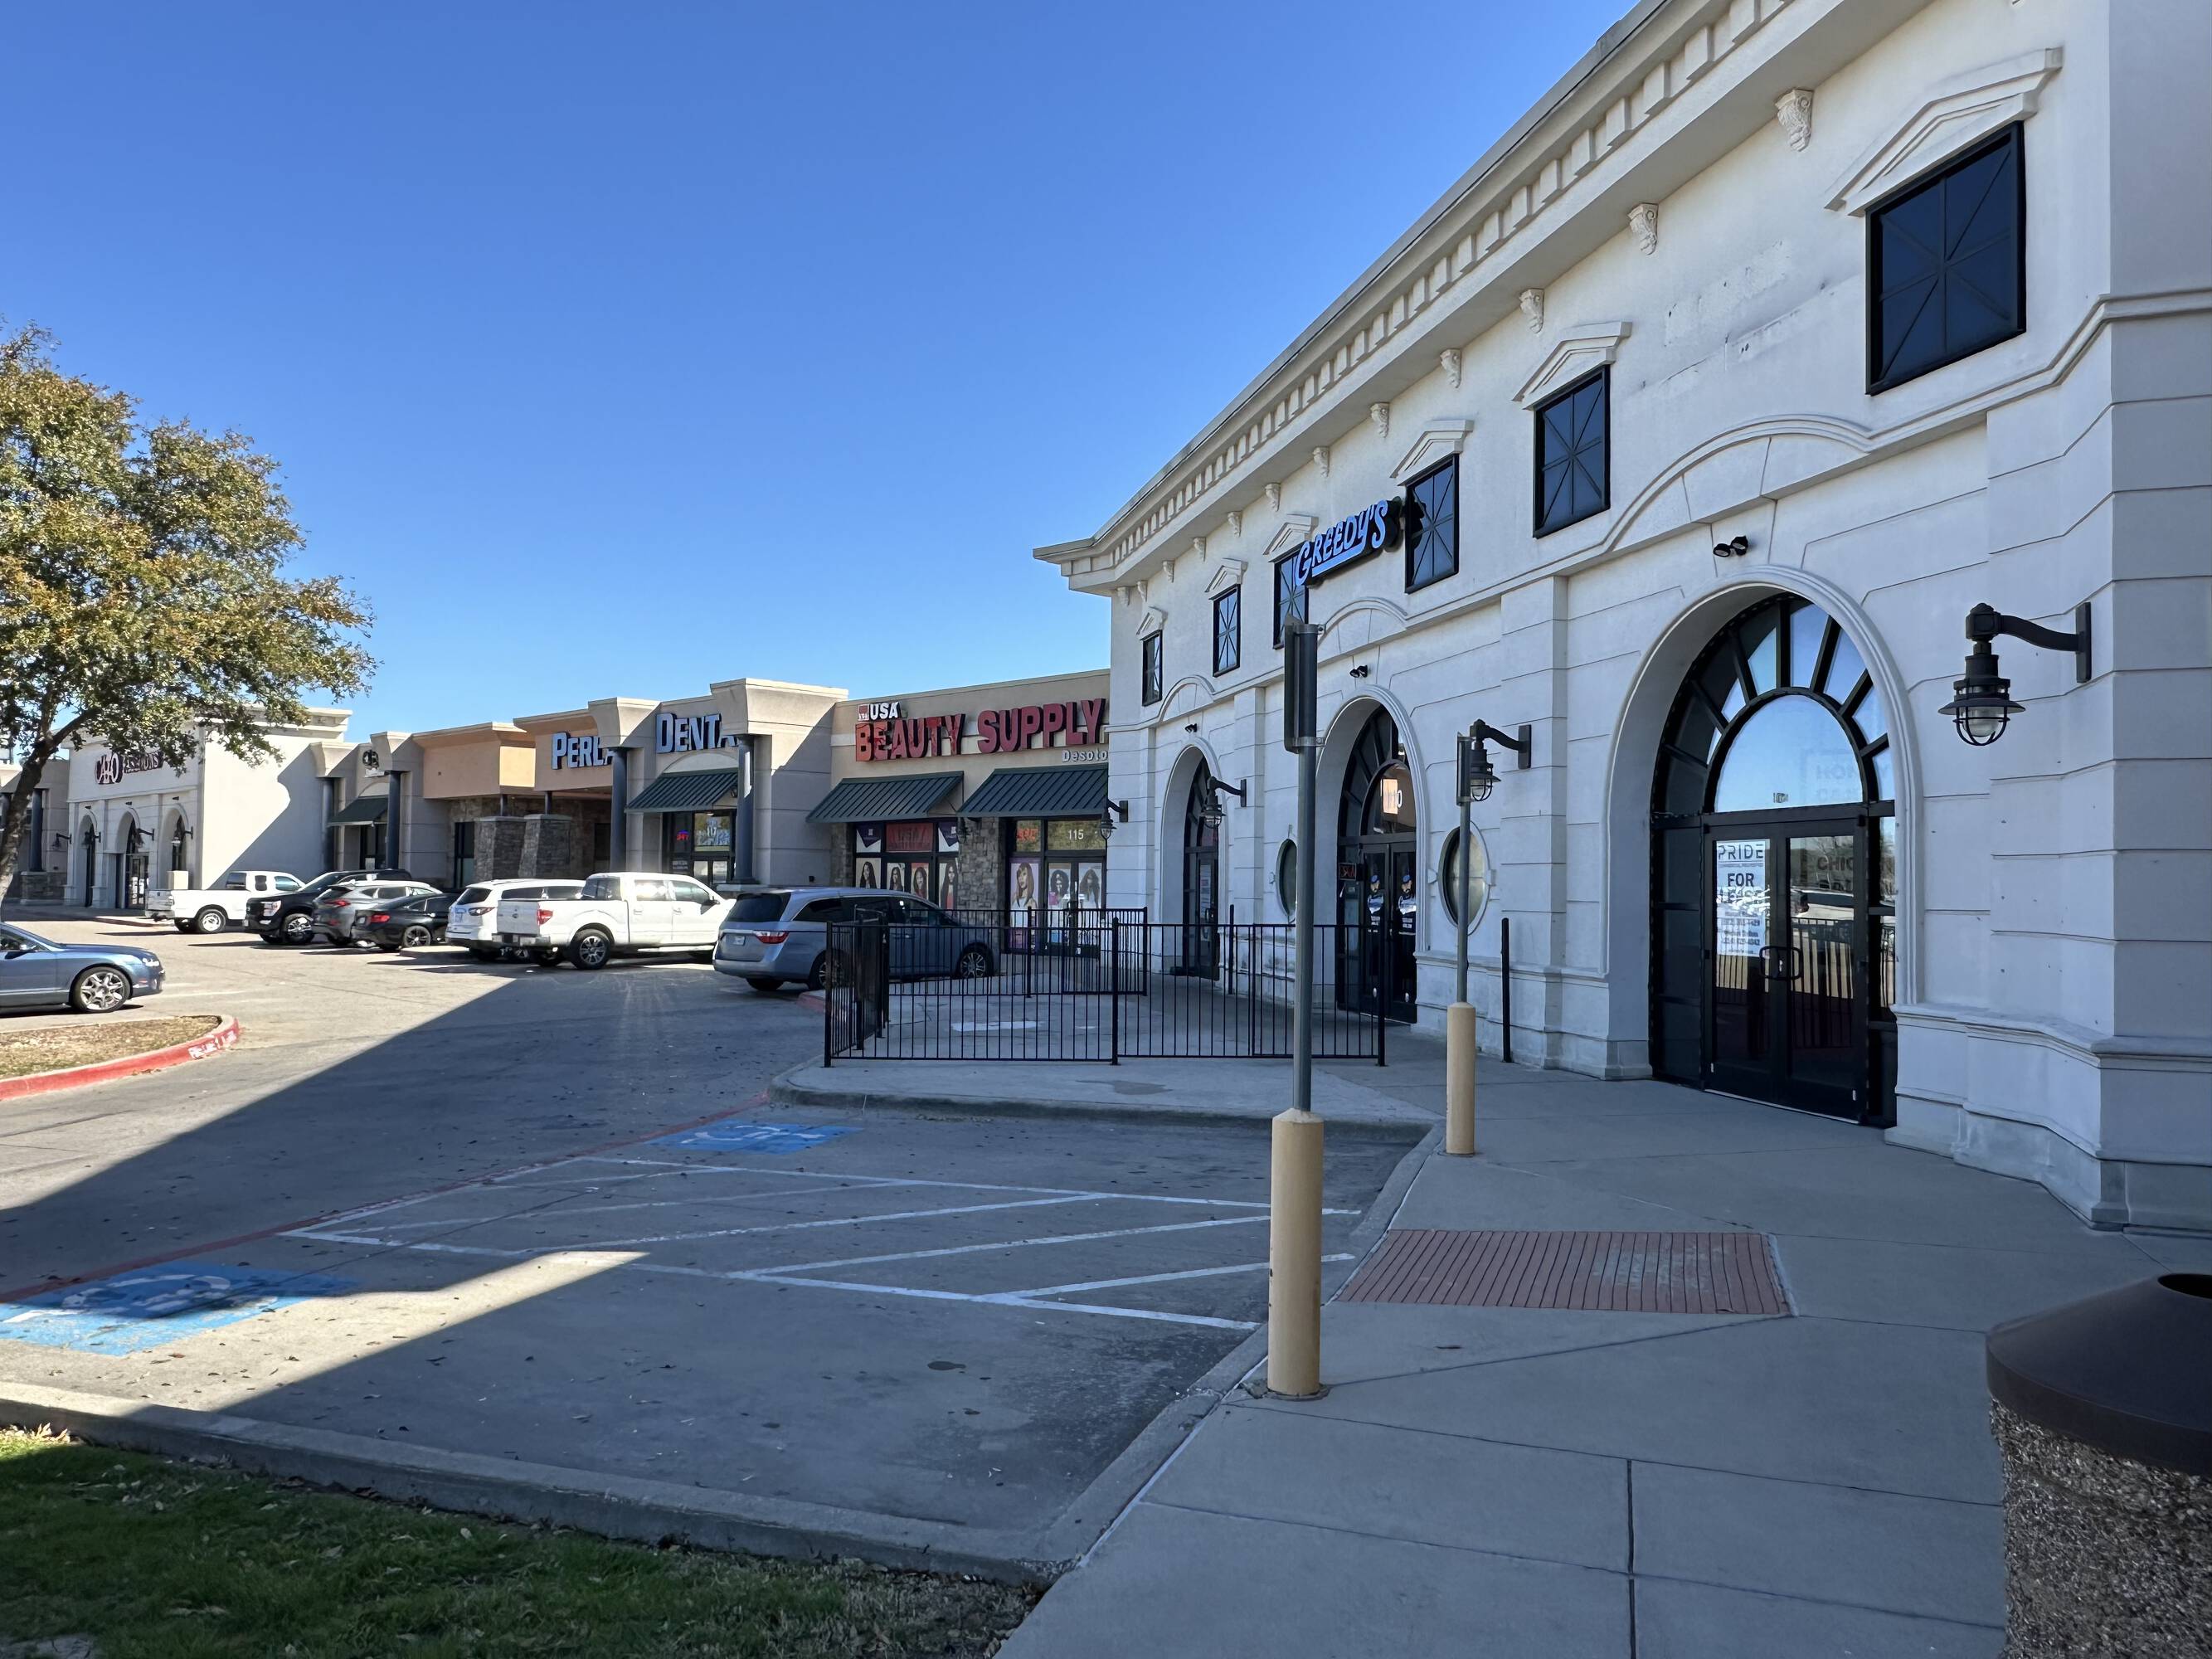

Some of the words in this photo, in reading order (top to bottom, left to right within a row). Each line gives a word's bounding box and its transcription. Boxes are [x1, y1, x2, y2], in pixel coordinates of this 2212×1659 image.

[1295, 499, 1388, 586] GREEDY'S
[870, 701, 900, 720] USA
[856, 713, 964, 761] BEAUTY
[977, 698, 1106, 753] SUPPLY
[1067, 829, 1085, 841] 115
[1718, 844, 1764, 860] PRIDE
[1728, 873, 1755, 888] FOR
